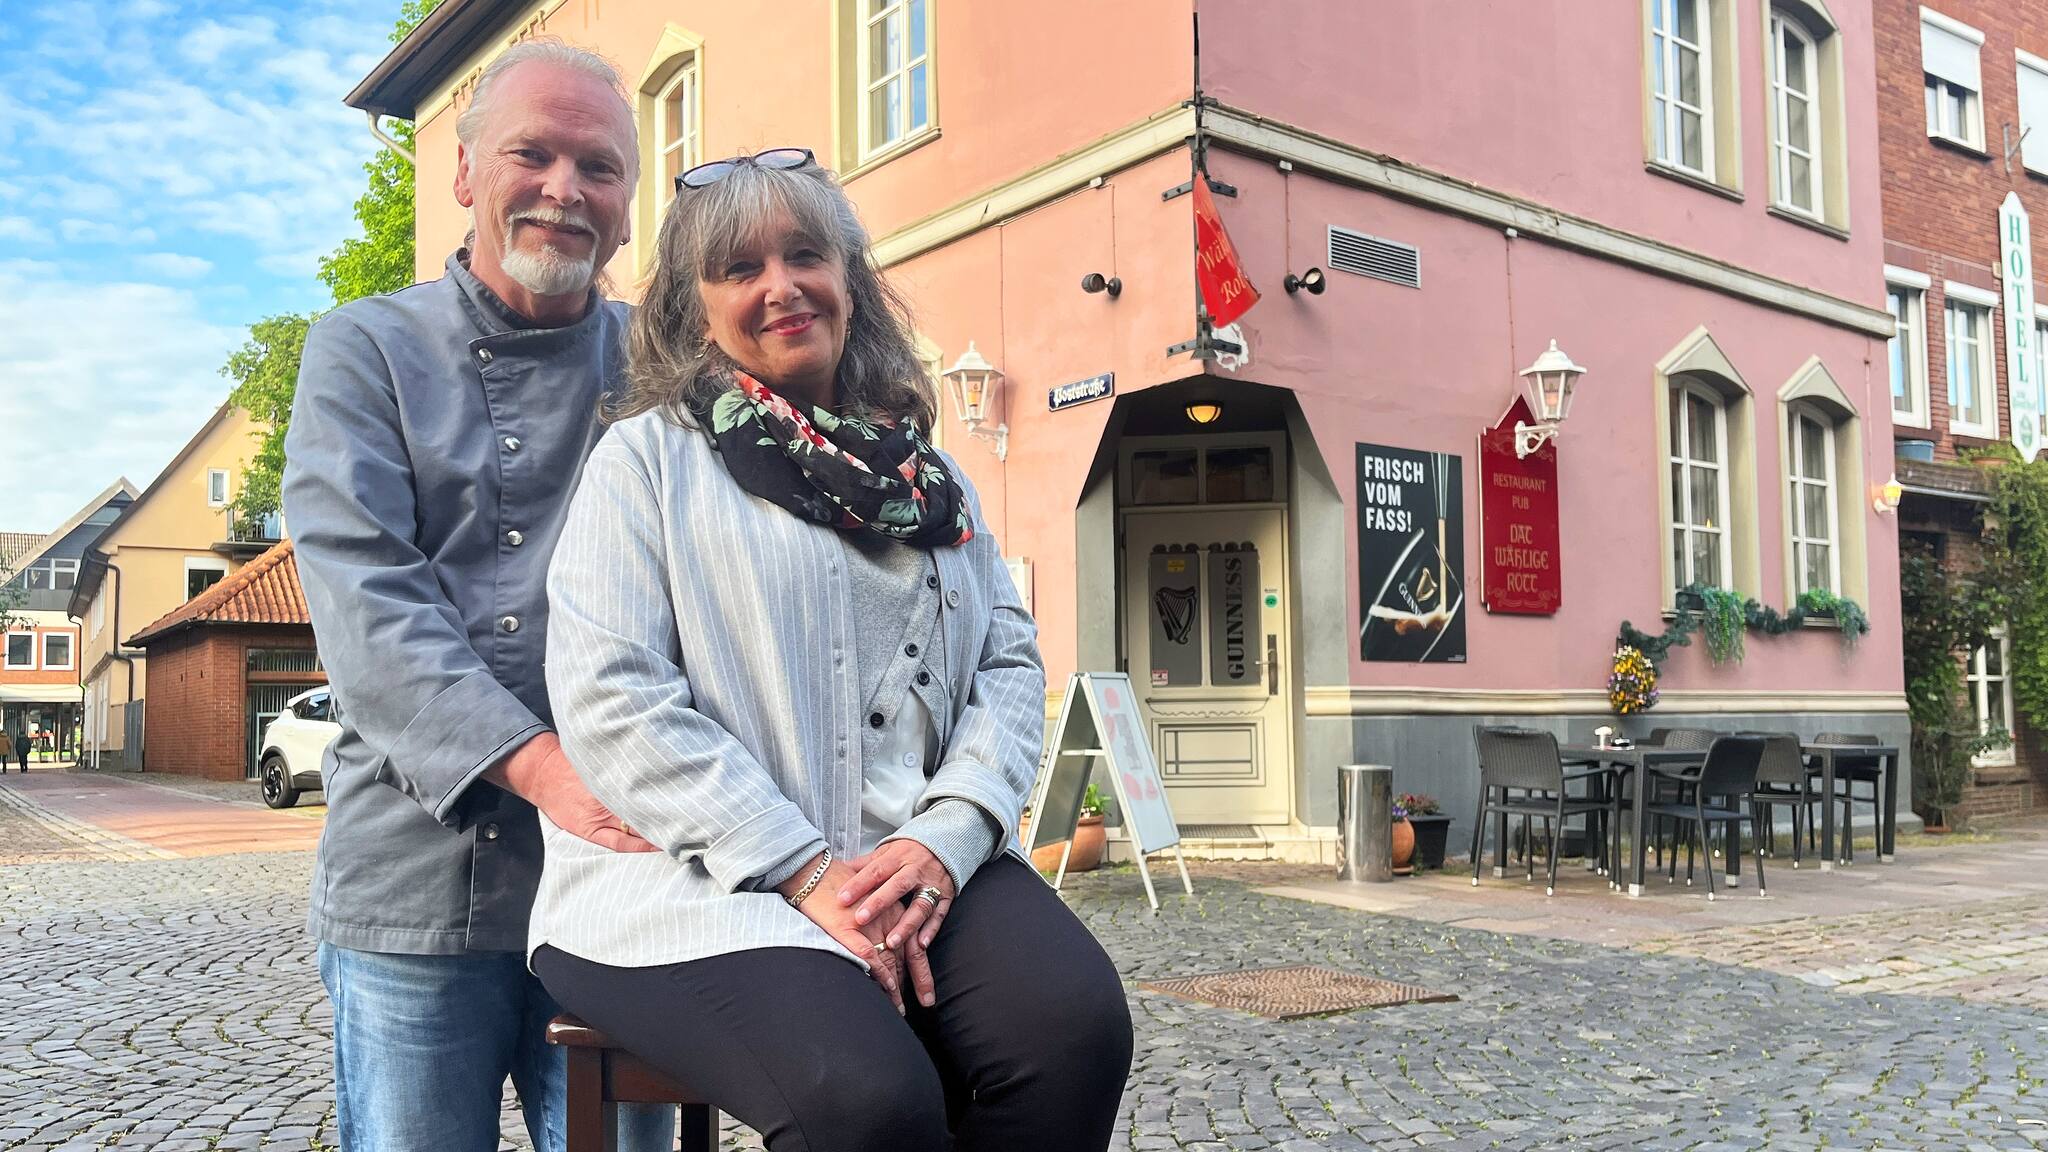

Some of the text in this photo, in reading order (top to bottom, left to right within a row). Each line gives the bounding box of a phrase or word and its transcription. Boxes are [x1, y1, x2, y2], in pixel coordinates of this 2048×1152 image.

[2008, 213, 2029, 383] HOTEL
[1364, 455, 1425, 484] FRISCH
[1493, 472, 1547, 491] RESTAURANT
[1365, 481, 1402, 507] VOM
[1511, 495, 1530, 510] PUB
[1366, 507, 1412, 533] FASS!
[1509, 524, 1533, 545] DAT
[1507, 572, 1538, 593] ROTT
[1225, 556, 1246, 680] GUINNESS
